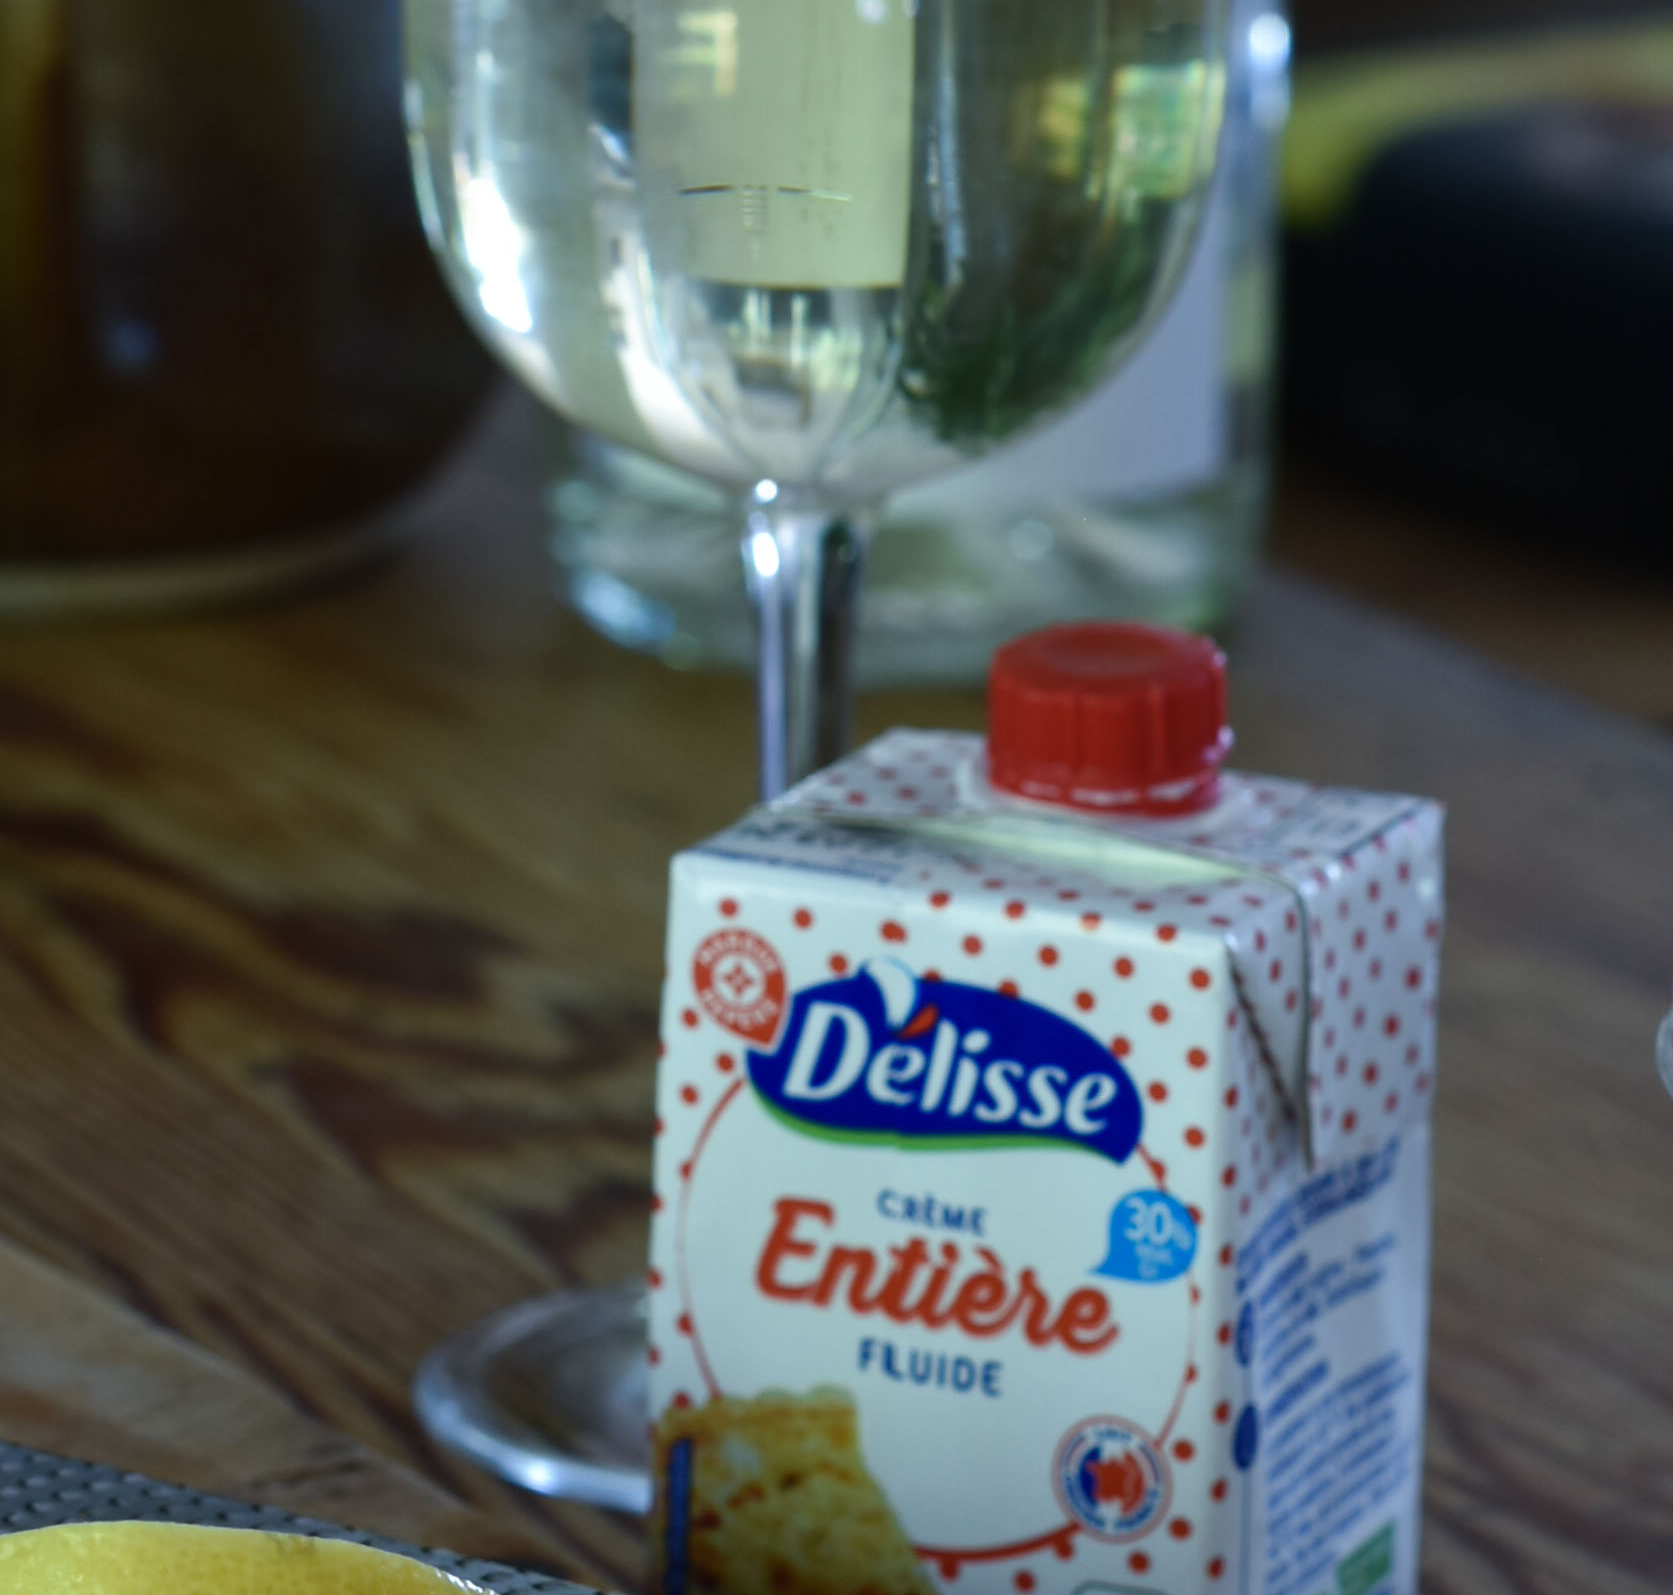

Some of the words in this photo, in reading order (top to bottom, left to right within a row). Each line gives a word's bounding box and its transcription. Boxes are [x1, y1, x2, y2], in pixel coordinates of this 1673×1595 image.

[782, 1000, 1117, 1135] Délisse
[877, 1191, 987, 1235] CRÈME
[757, 1198, 1118, 1355] Entière
[858, 1337, 1004, 1398] FLUIDE
